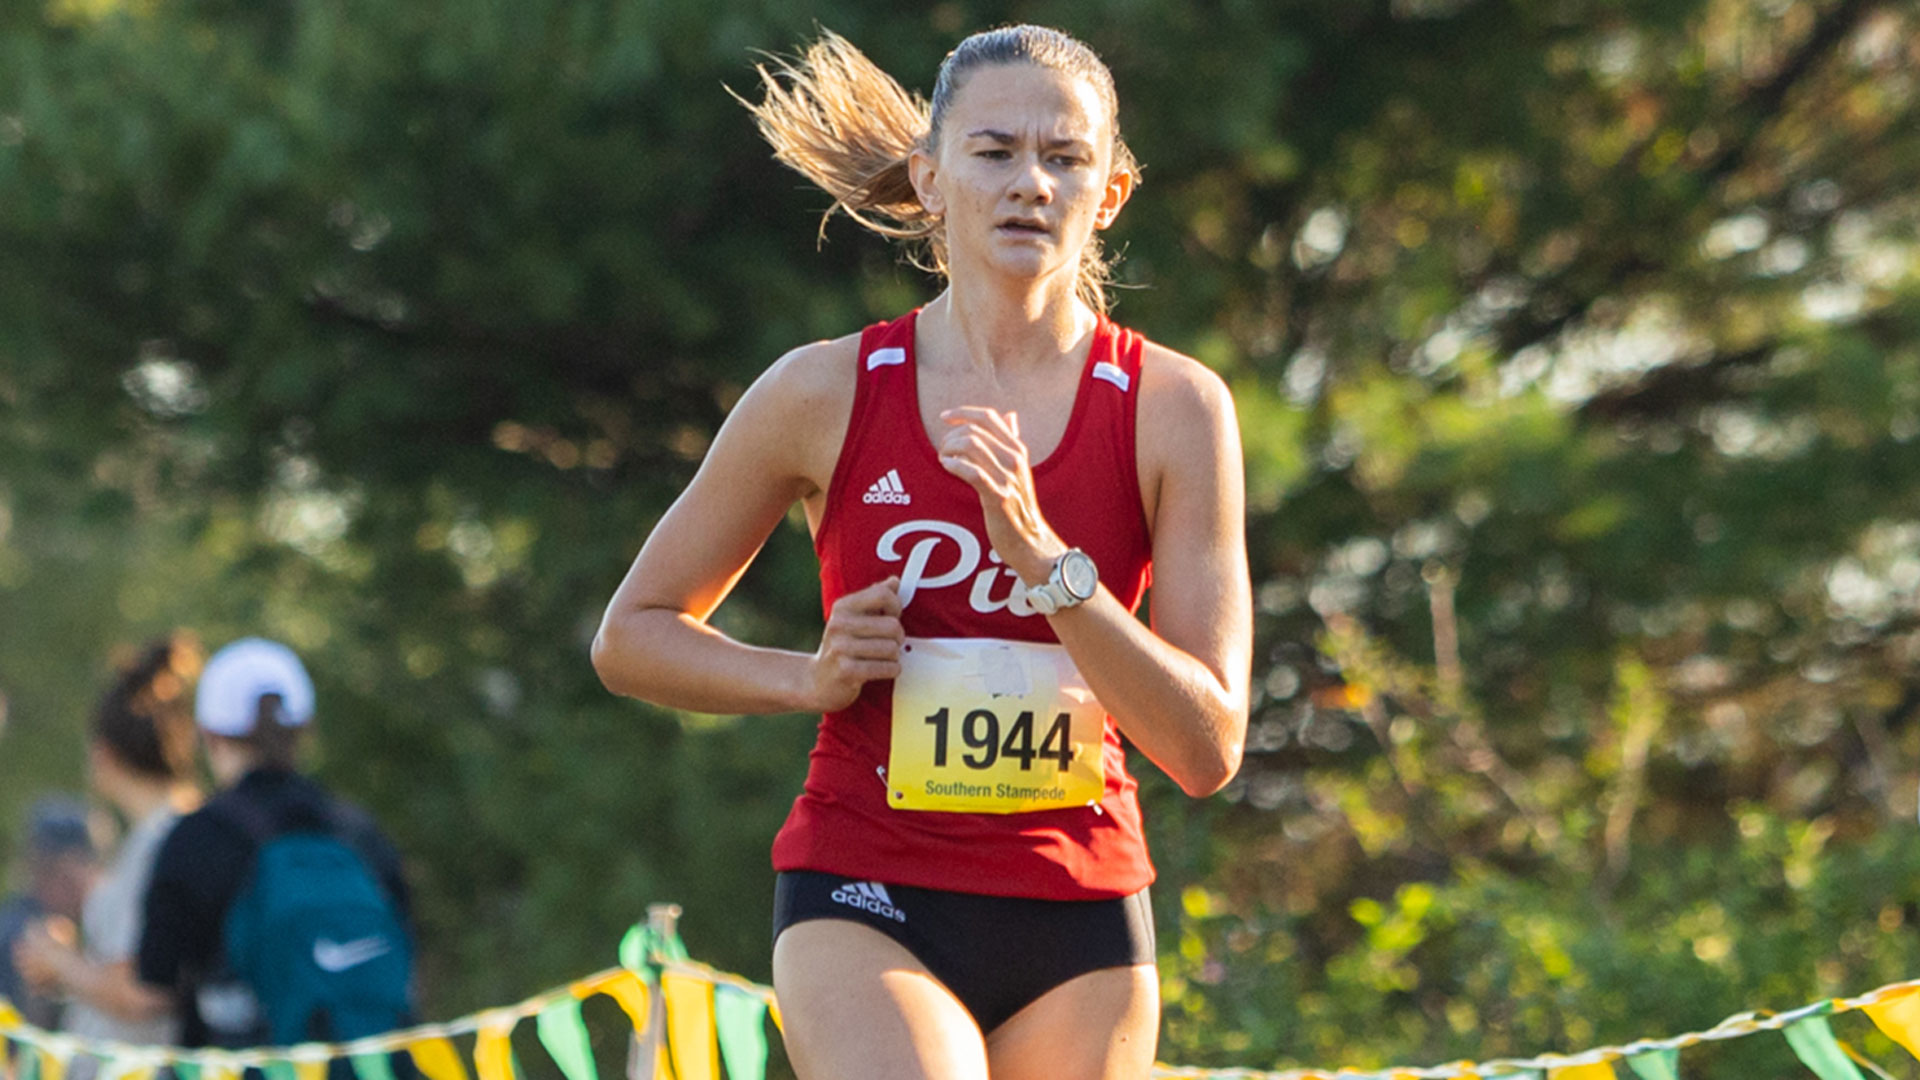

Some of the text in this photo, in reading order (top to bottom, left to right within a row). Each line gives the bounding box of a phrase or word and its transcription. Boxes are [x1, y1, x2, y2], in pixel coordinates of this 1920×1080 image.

[862, 490, 911, 505] adidas
[924, 707, 1074, 772] 1944
[925, 780, 1066, 801] Southern Stampede
[831, 889, 906, 923] adidas
